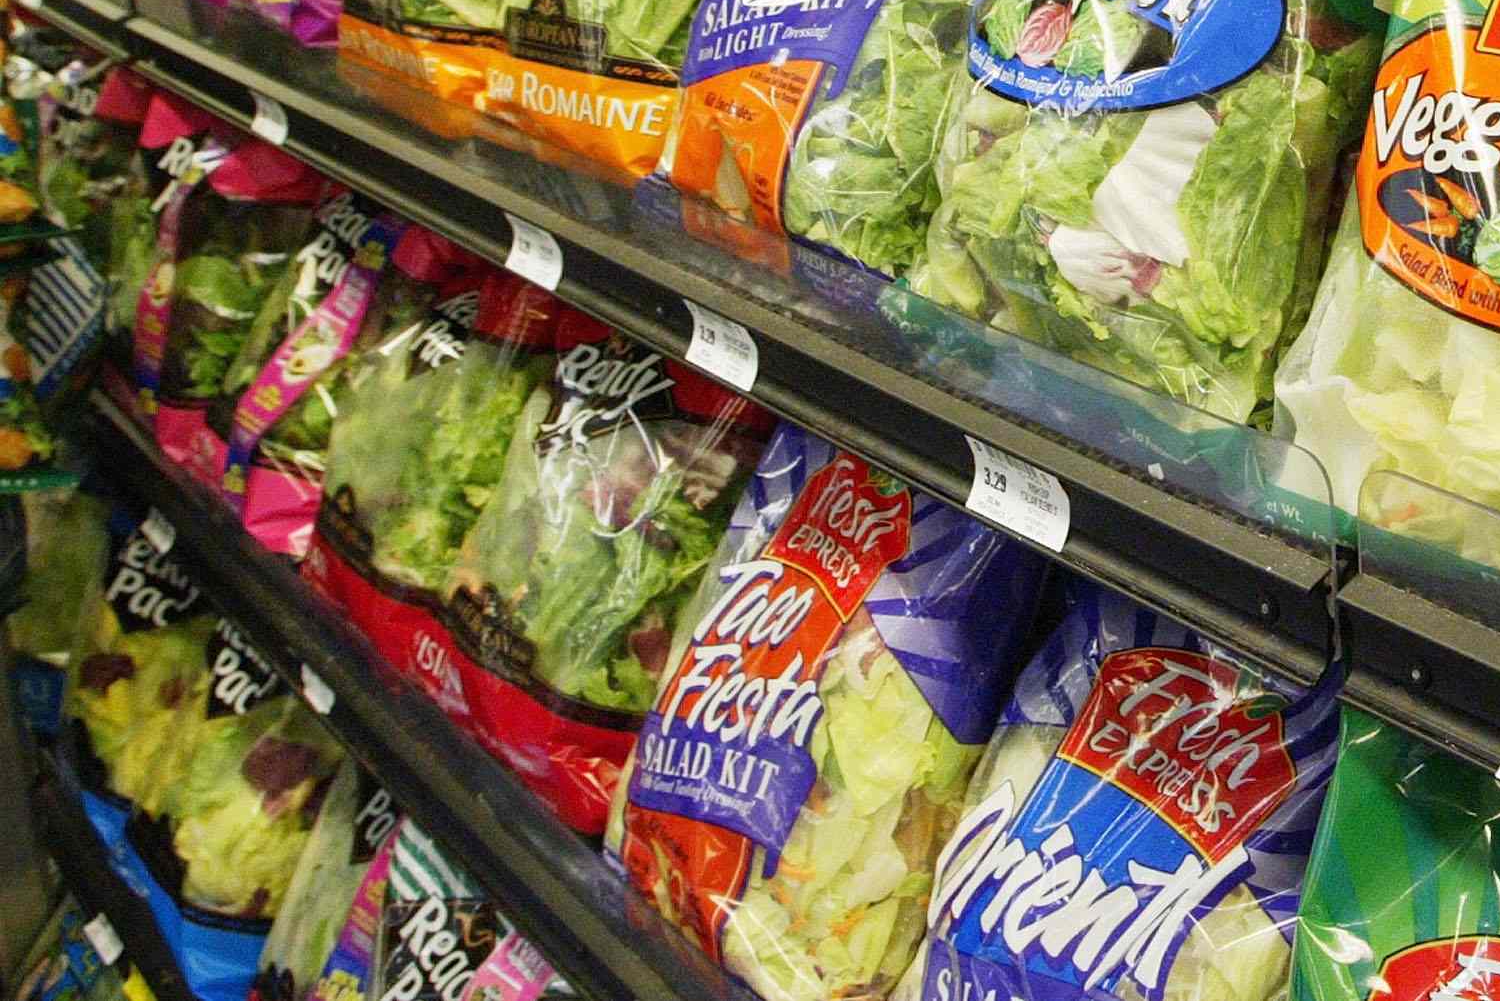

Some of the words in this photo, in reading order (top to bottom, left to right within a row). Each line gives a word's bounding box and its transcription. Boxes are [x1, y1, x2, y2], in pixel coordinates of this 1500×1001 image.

[712, 22, 784, 60] LIGHT
[520, 71, 667, 137] ROMAINE
[1399, 242, 1430, 279] Salad
[559, 343, 676, 420] Ready
[983, 466, 1008, 494] 3.29
[787, 524, 862, 591] EXPRESS
[692, 561, 812, 645] Taco
[659, 644, 824, 747] Fiesta
[1112, 654, 1264, 789] Fresh
[642, 732, 712, 780] SALAD
[718, 748, 780, 800] KIT
[1086, 721, 1241, 835] EXPRESS
[354, 788, 396, 849] Pa
[927, 780, 1250, 992] Orient
